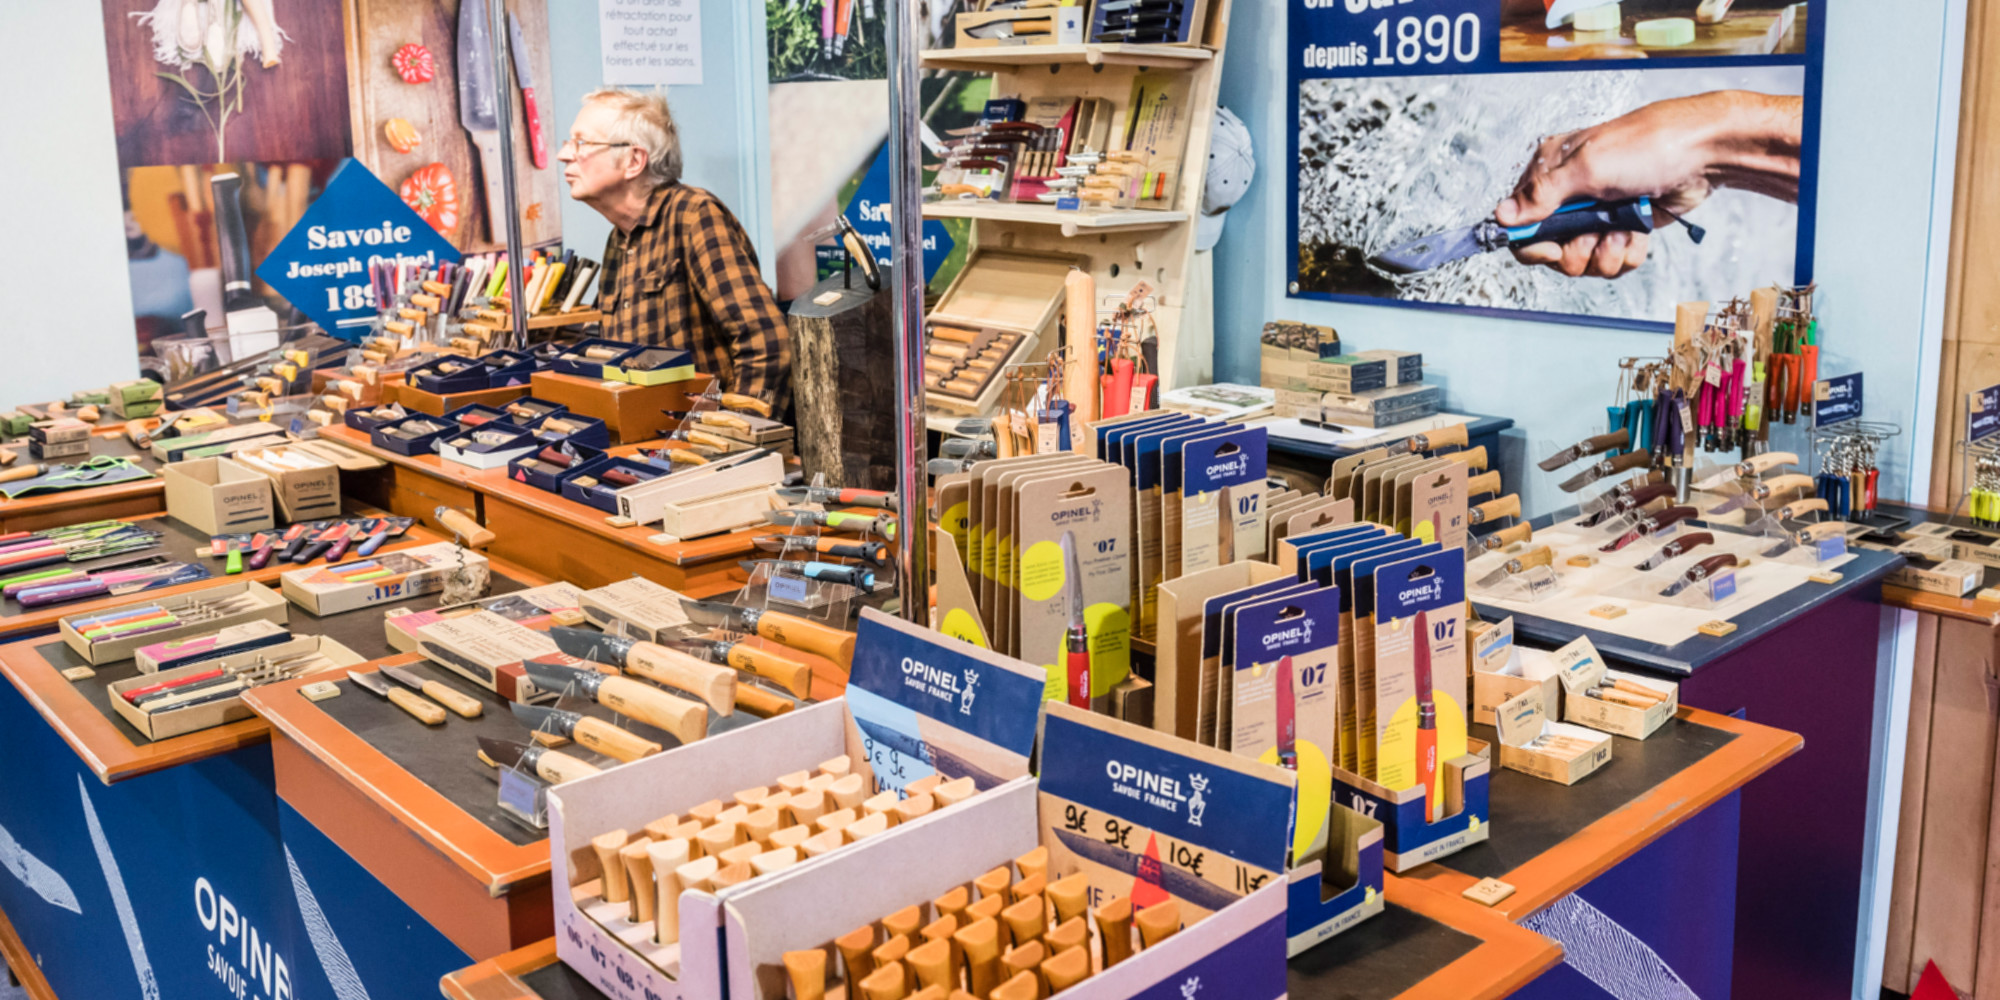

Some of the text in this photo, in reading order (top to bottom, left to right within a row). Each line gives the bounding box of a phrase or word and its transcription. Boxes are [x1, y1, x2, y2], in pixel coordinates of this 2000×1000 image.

[606, 10, 692, 23] rétractation pour
[623, 26, 678, 36] tout achat
[1303, 12, 1481, 69] depuis 1890
[613, 40, 689, 52] effectué sur les
[606, 56, 633, 66] foires
[635, 57, 646, 66] et
[648, 57, 661, 67] les
[307, 220, 411, 250] Savoie
[286, 256, 363, 279] Joseph
[1206, 461, 1240, 475] OPINEL
[223, 493, 258, 504] OPINEL
[1051, 507, 1091, 521] OPINEL
[1399, 584, 1434, 601] OPINEL
[1262, 627, 1303, 645] OPINEL
[901, 657, 962, 694] OPINEL
[904, 676, 954, 703] SAVOIE FRANCE
[1106, 760, 1187, 802] OPINEL
[1112, 782, 1177, 812] SAVOIE FRANCE
[1065, 804, 1088, 833] 9€
[1104, 819, 1133, 850] 9€
[1170, 841, 1204, 877] 10€
[1423, 847, 1439, 857] MADE
[1445, 836, 1466, 849] FRANCE
[1317, 925, 1334, 938] MADE
[1341, 909, 1361, 925] FRANCE
[194, 876, 293, 1000] OPINE
